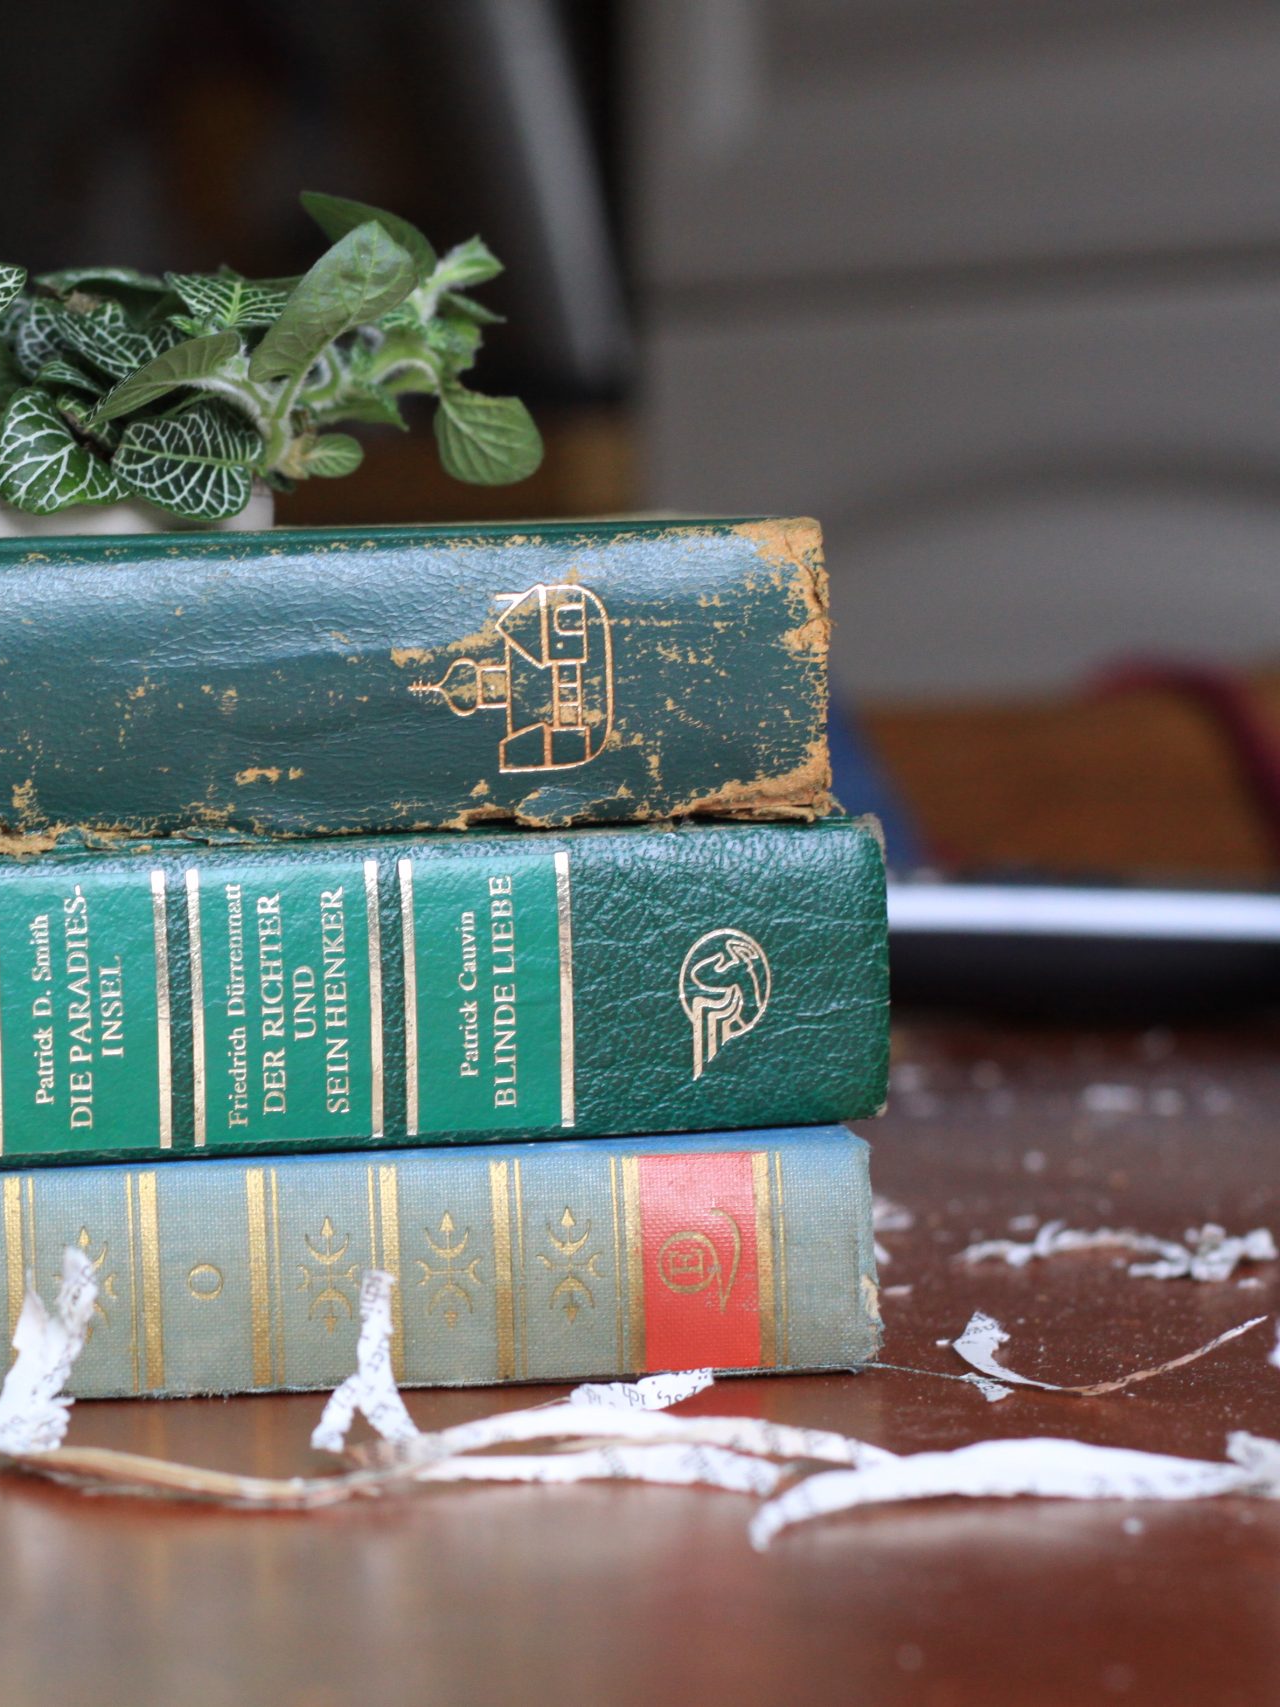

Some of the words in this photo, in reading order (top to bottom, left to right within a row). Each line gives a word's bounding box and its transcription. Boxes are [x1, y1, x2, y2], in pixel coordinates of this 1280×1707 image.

[29, 914, 52, 982] Smith
[225, 883, 246, 1017] Dürrenmatt
[256, 892, 285, 1041] RICHTER
[320, 885, 349, 1031] HENKER
[455, 910, 478, 992] Cauvin
[488, 875, 516, 976] LIEBE
[33, 991, 53, 1019] D.
[64, 884, 93, 1063] PARADIES-
[99, 955, 124, 1058] INSEL
[292, 965, 317, 1042] UND
[33, 1025, 55, 1105] Patrick
[228, 1025, 248, 1129] Friedrich
[325, 1037, 350, 1115] SEIN
[459, 999, 479, 1078] Patrick
[493, 983, 518, 1109] BLINDE
[70, 1071, 93, 1130] DIE
[262, 1047, 287, 1116] DER
